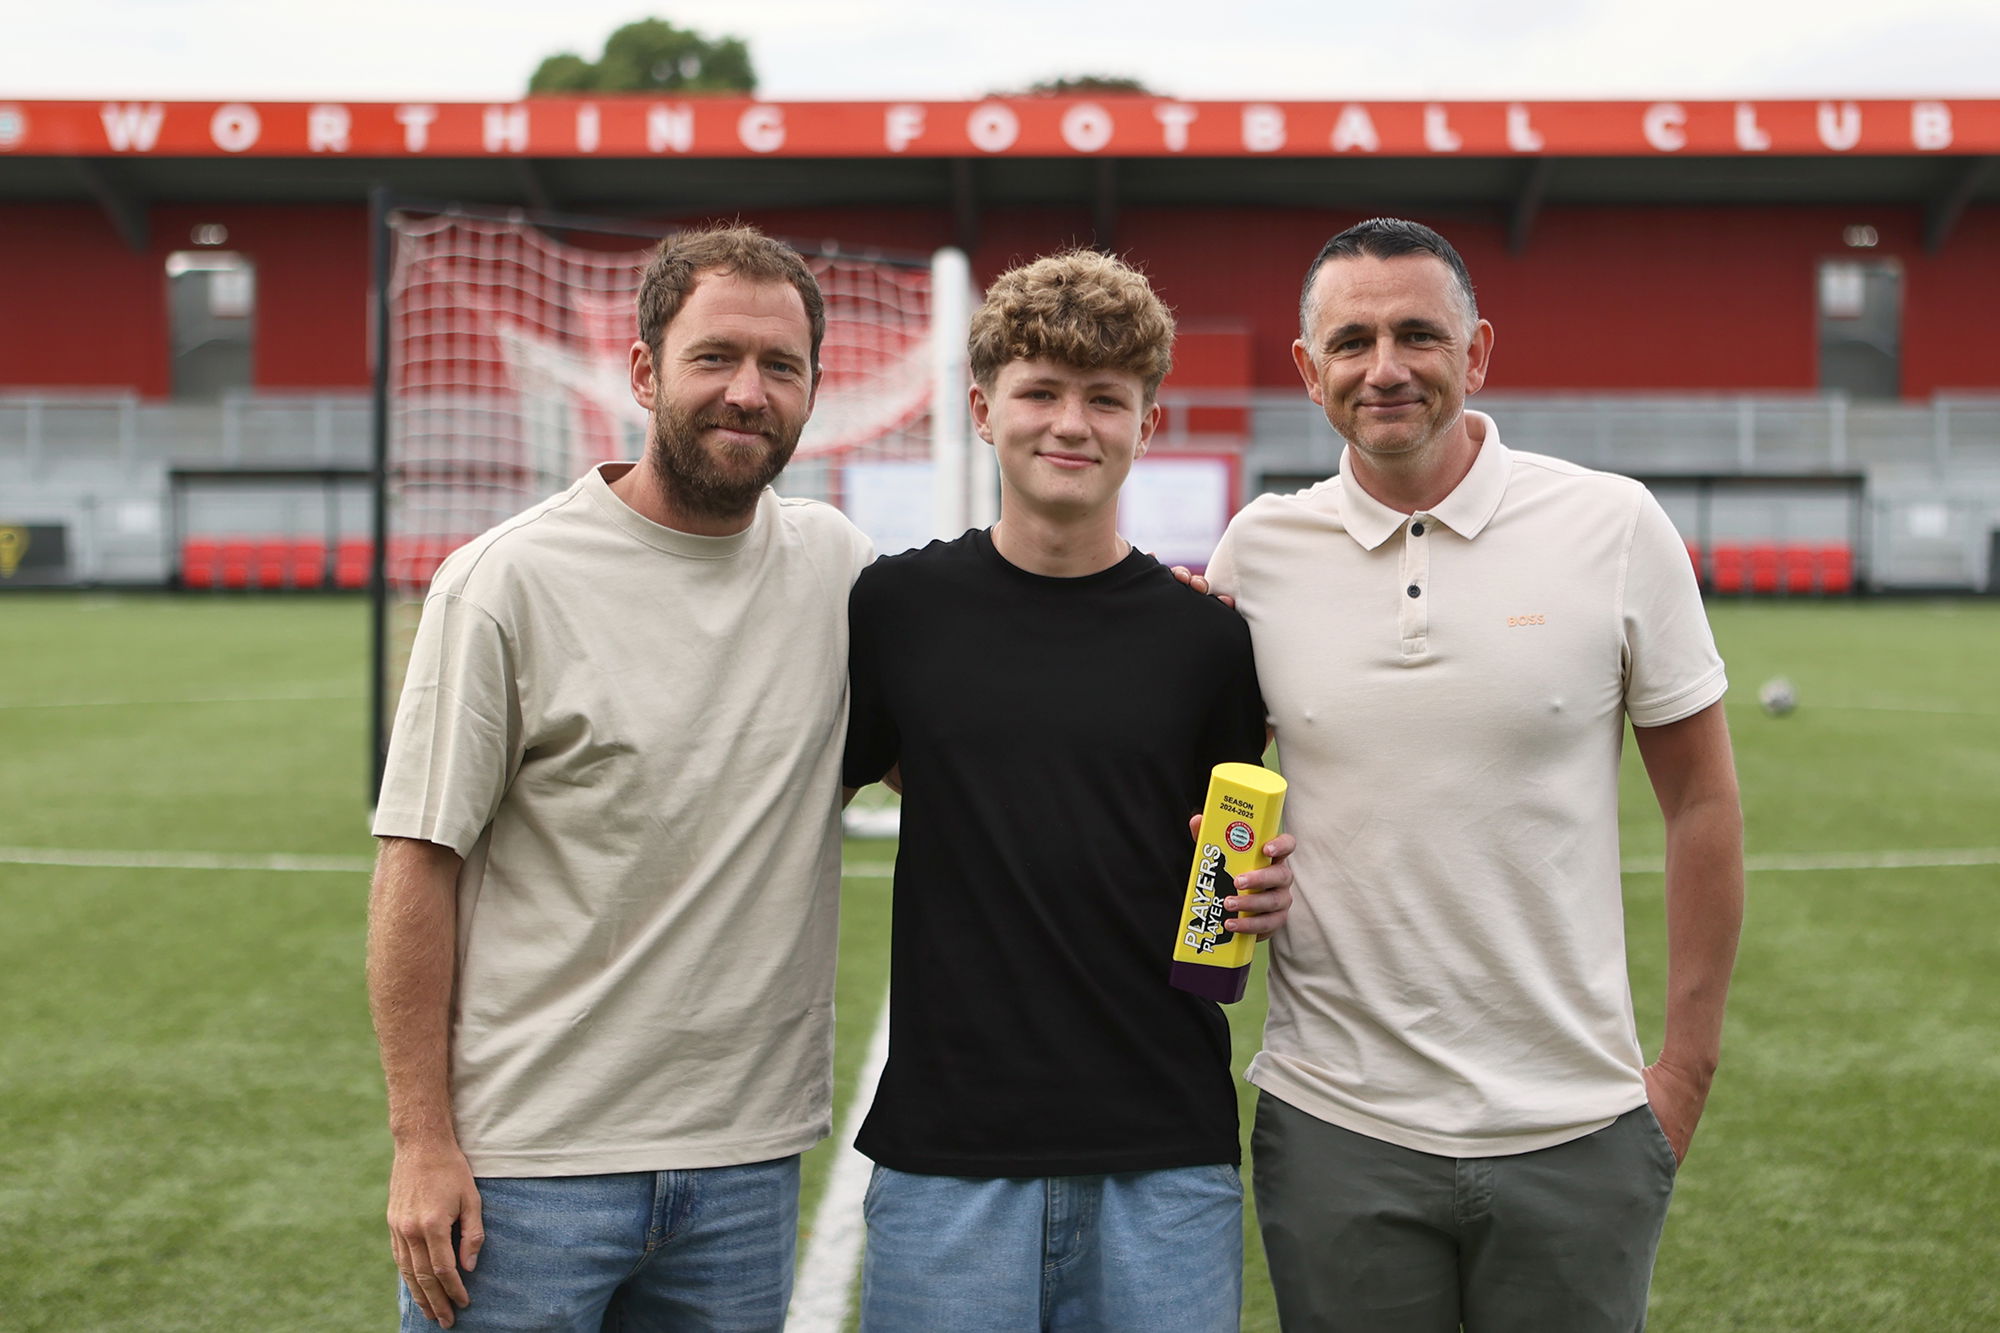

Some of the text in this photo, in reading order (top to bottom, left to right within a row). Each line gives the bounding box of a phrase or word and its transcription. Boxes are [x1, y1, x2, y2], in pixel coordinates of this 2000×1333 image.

[100, 101, 1954, 152] WORTHING FOOTBALL CLUB
[1507, 614, 1546, 627] BOSS
[1219, 802, 1255, 819] 2024-2025
[1223, 795, 1254, 811] SEASON
[1183, 843, 1222, 949] PLAYERS
[1202, 897, 1224, 953] PLAYER
